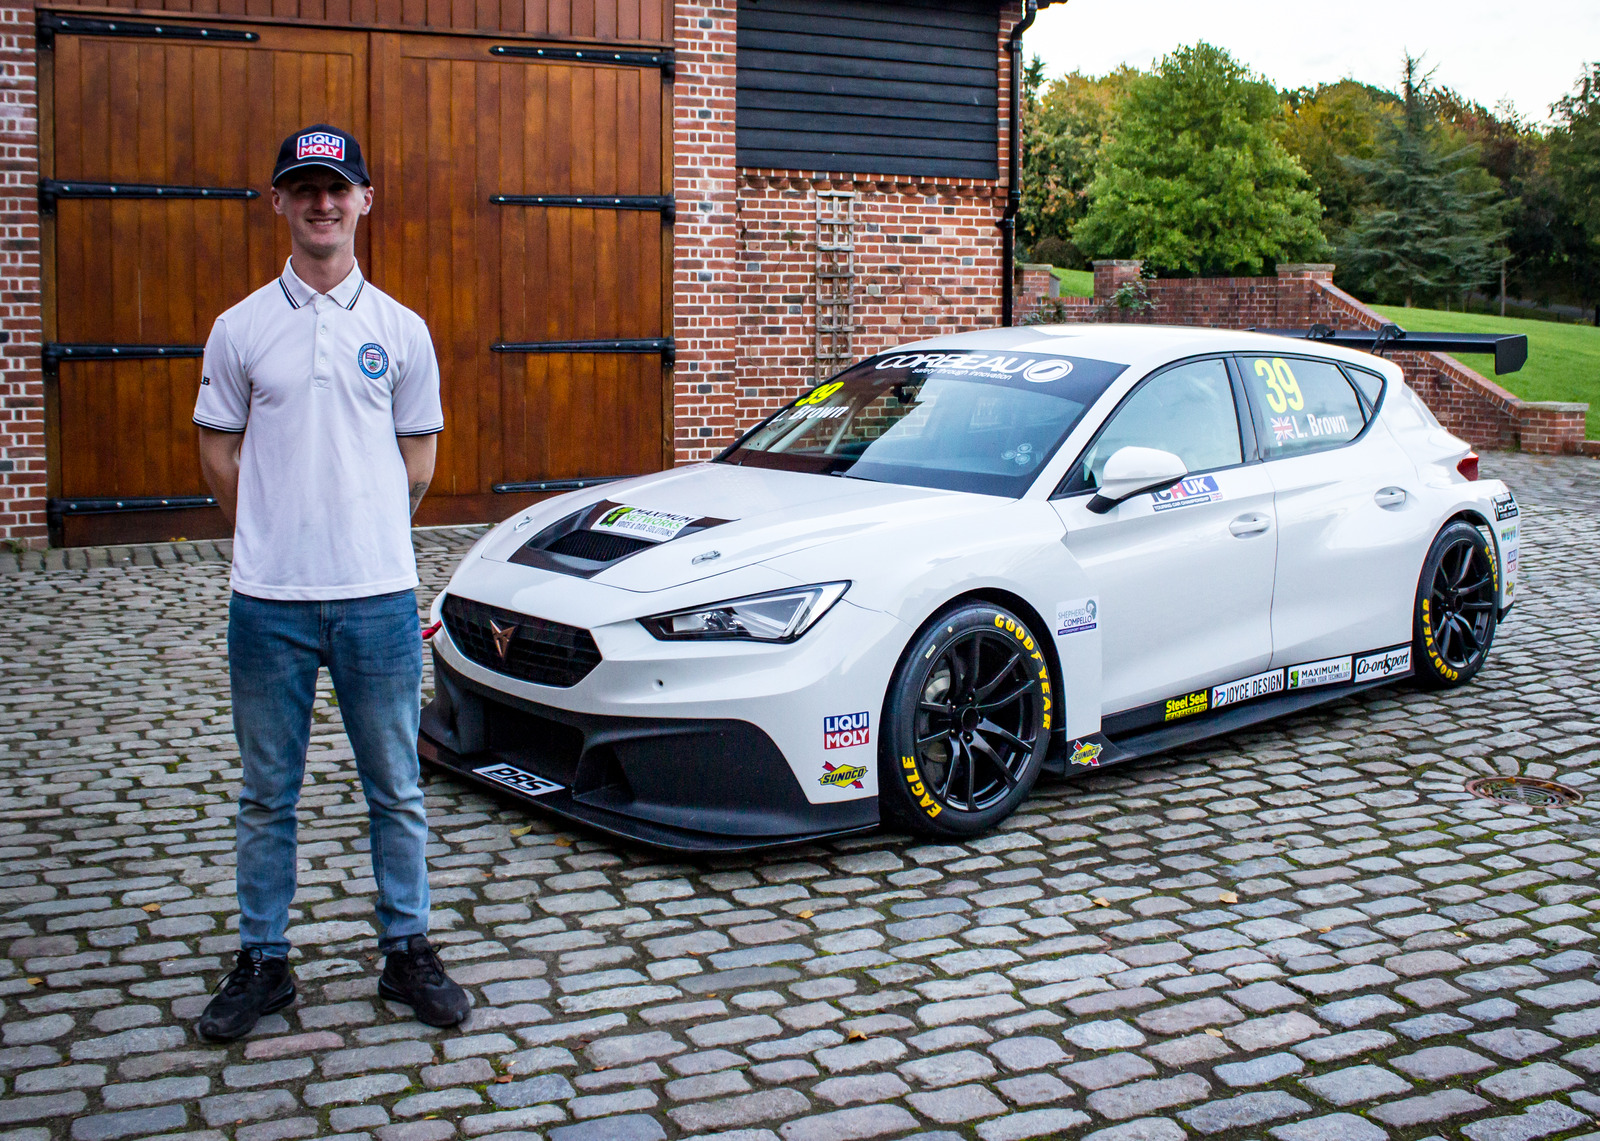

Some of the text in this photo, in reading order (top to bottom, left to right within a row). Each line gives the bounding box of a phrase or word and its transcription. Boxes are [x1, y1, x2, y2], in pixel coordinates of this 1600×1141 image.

[301, 134, 341, 147] LIQUI
[301, 144, 340, 156] MOLY
[875, 354, 1036, 373] CORBEAU
[937, 367, 969, 377] through
[969, 370, 1012, 381] innovation
[795, 381, 845, 407] 39
[1254, 358, 1304, 414] 39
[788, 405, 849, 420] Brown
[1291, 413, 1349, 439] L. Brown
[1182, 478, 1211, 494] UK
[622, 513, 683, 530] NETWORKS
[632, 509, 695, 523] MAXIMUM
[646, 525, 675, 537] SOLUTIONS
[1058, 608, 1085, 620] SHEPHERD
[1064, 615, 1092, 627] COMPELLO
[994, 613, 1052, 730] GOODYEAR
[1301, 664, 1340, 678] MAXIMUM
[1225, 674, 1283, 704] JOYCE DESIGN
[1165, 690, 1208, 713] Steel Seal
[826, 713, 868, 732] LIQUI
[826, 728, 869, 749] MOLY
[822, 768, 865, 784] SUNOCO
[902, 755, 943, 818] EAGLE
